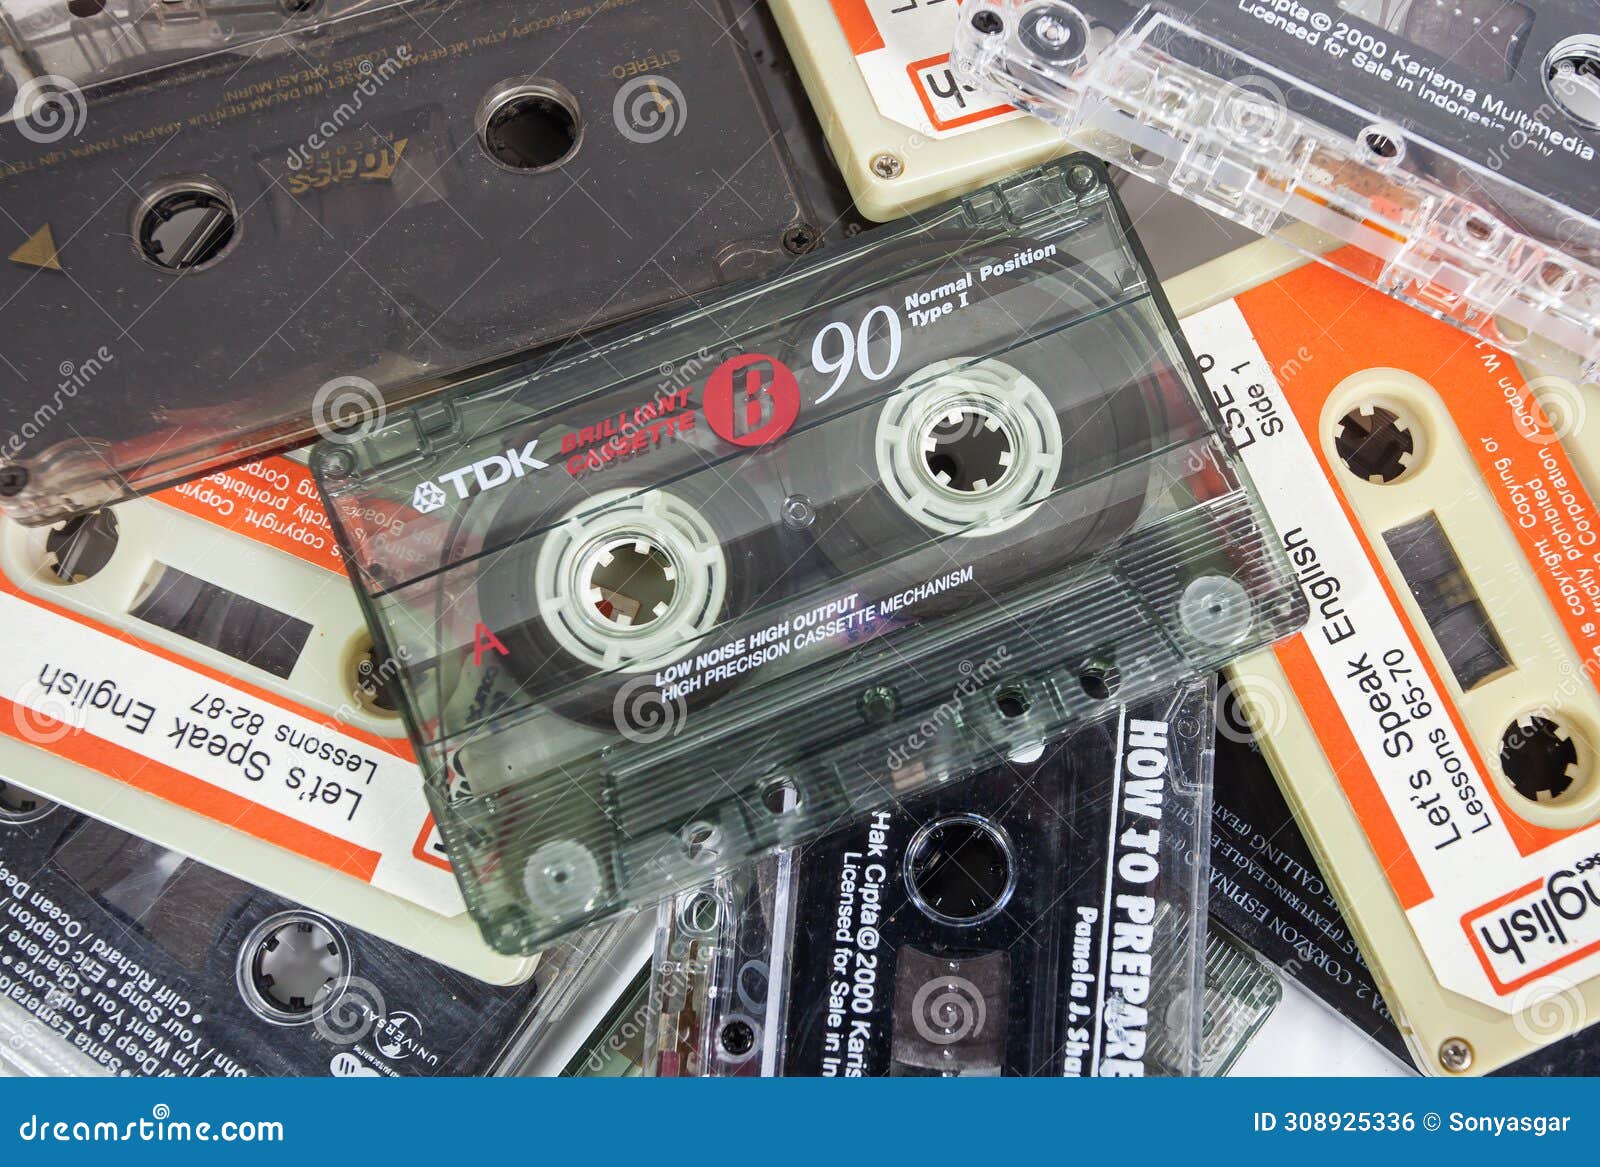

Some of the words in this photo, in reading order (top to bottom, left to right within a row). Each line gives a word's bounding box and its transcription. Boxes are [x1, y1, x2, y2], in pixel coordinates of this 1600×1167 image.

[612, 48, 681, 79] STEREO
[1235, 0, 1323, 48] Licensed
[1320, 35, 1352, 61] for
[1352, 52, 1393, 81] Sale
[1397, 76, 1413, 91] in
[1332, 23, 1386, 58] 2000
[1391, 51, 1476, 103] Karisma
[1482, 94, 1594, 160] Multimedia
[905, 272, 973, 311] Normal
[980, 243, 1057, 282] Position
[907, 301, 953, 328] Type
[811, 305, 902, 405] 90
[1231, 361, 1250, 374] 1
[1479, 349, 1503, 374] W
[1248, 384, 1283, 436] Side
[1498, 377, 1540, 440] London
[439, 440, 549, 499] TDK
[1478, 432, 1500, 455] or
[1495, 458, 1536, 528] Copying
[245, 508, 324, 548] copyright.
[1279, 526, 1355, 645] English
[473, 621, 510, 667] A
[655, 659, 695, 688] LOW
[695, 637, 746, 673] NOISE
[750, 620, 790, 650] HIGH
[793, 593, 859, 632] OUTPUT
[661, 676, 702, 704] HIGH
[704, 642, 791, 688] PRECISION
[793, 608, 877, 649] CASSETTE
[879, 566, 974, 618] MECHANISM
[1576, 619, 1599, 641] is
[39, 663, 156, 734] English
[1347, 652, 1413, 758] Speak
[1383, 649, 1431, 719] 65-70
[190, 694, 264, 735] 82-87
[168, 718, 270, 781] Speak
[275, 725, 377, 784] Lessons
[1126, 719, 1169, 819] HOW
[286, 767, 362, 821] Let's
[1429, 728, 1491, 833] Lessons
[866, 809, 891, 858] Hak
[1410, 770, 1461, 850] Let's
[0, 861, 29, 900] Dee
[1119, 828, 1160, 883] TO
[1249, 834, 1325, 896] CALLING
[31, 893, 81, 937] Ocean
[836, 852, 862, 942] Licensed
[855, 862, 887, 926] Cipta
[1262, 877, 1343, 943] (FEATURING
[8, 903, 70, 955] Clapton
[1070, 907, 1098, 997] Pamela
[1269, 918, 1353, 985] CORAZON
[8, 930, 80, 990] Charlene
[14, 961, 57, 1000] Love
[72, 951, 107, 983] Eric
[91, 939, 156, 991] Richard
[833, 948, 852, 975] for
[851, 953, 877, 1013] 2000
[93, 992, 125, 1025] You
[118, 982, 162, 1023] Song
[152, 986, 190, 1017] Cliff
[828, 981, 849, 1027] Sale
[1069, 1002, 1090, 1022] J.
[1350, 978, 1372, 1000] 2.
[74, 1031, 122, 1074] Santa
[98, 1023, 116, 1042] Is
[116, 1037, 160, 1073] Deep
[126, 1017, 170, 1057] Want
[162, 1018, 201, 1054] Your
[360, 1007, 438, 1066] UNIVERSAL
[825, 1033, 843, 1051] in
[1065, 1024, 1091, 1077] Sha
[174, 1052, 200, 1077] I'm
